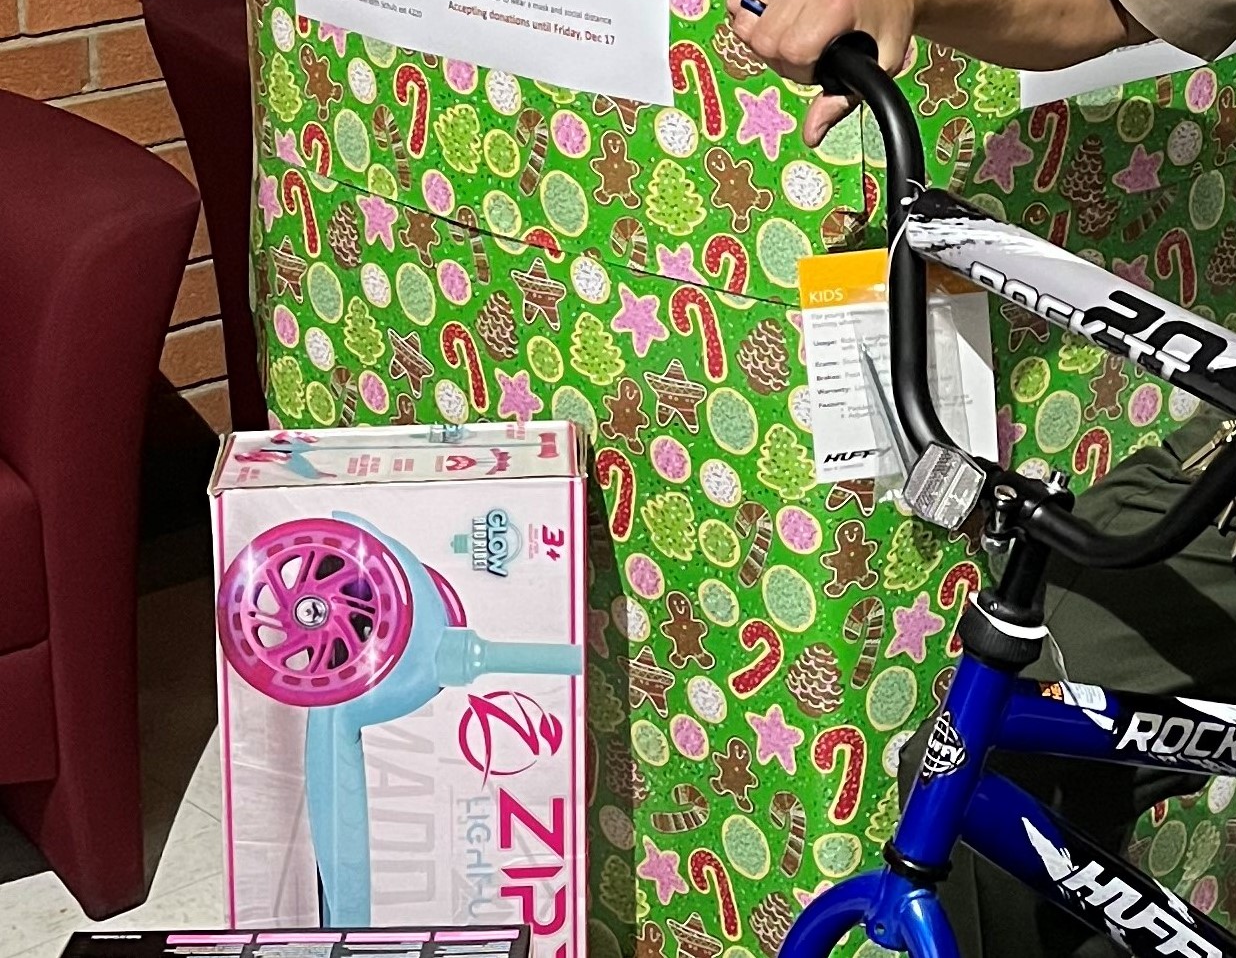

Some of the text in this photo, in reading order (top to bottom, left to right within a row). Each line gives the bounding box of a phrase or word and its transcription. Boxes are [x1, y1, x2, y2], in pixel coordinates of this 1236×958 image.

[448, 0, 487, 20] Accepting
[489, 9, 530, 28] donations
[533, 19, 552, 33] until
[585, 31, 602, 43] Dec
[604, 34, 615, 45] 17
[809, 288, 843, 303] KIDS
[1083, 290, 1229, 373] 20
[487, 509, 508, 578] GLOW
[542, 524, 564, 561] 3+
[497, 787, 565, 958] ZIP
[1062, 860, 1222, 958] HUFF
